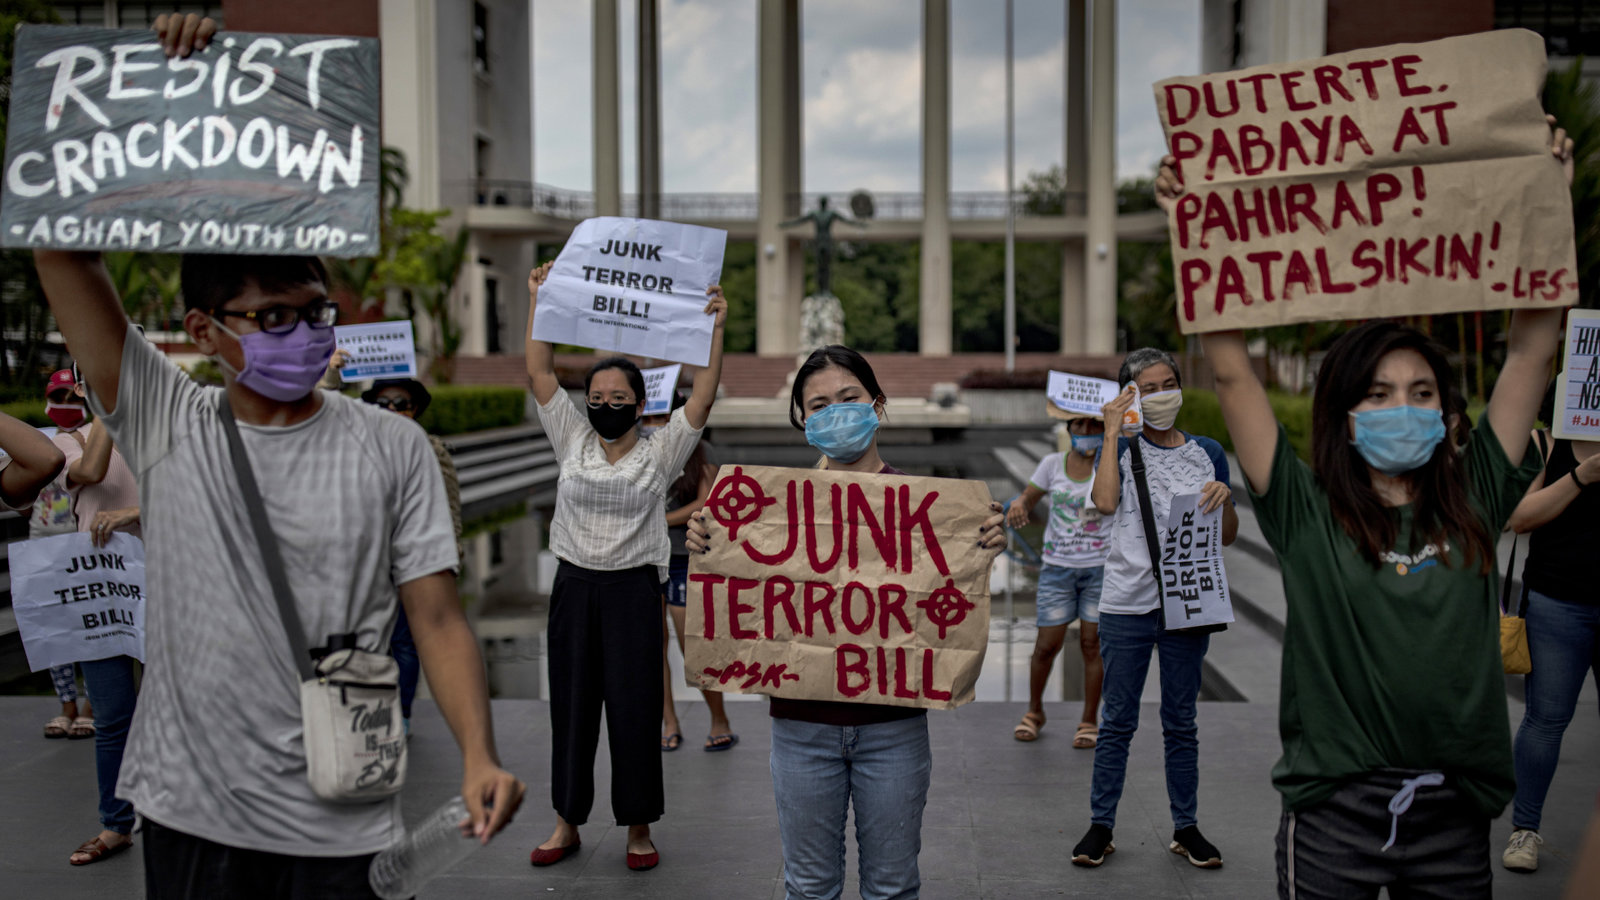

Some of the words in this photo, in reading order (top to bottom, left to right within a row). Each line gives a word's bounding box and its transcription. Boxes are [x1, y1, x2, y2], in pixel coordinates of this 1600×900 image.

[7, 115, 364, 198] CRACKDOWN
[1171, 114, 1375, 186] PABAYA
[1393, 100, 1458, 153] AT
[179, 219, 287, 249] YOUTH
[1174, 165, 1427, 250] PAHIRAP!
[582, 265, 673, 294] TERROR
[600, 239, 663, 262] JUNK
[1179, 220, 1502, 323] PATALSIKIN!
[592, 294, 650, 319] BILL!
[741, 479, 951, 577] JUNK
[66, 553, 126, 574] JUNK
[1163, 526, 1184, 600] JUNK
[1178, 509, 1202, 620] TERROR
[1196, 525, 1214, 592] BILL!
[54, 580, 141, 605] TERROR
[82, 608, 135, 630] BILL!
[689, 574, 914, 641] TERROR
[837, 643, 952, 702] BILL
[350, 699, 392, 735] Today
[364, 734, 378, 751] IS
